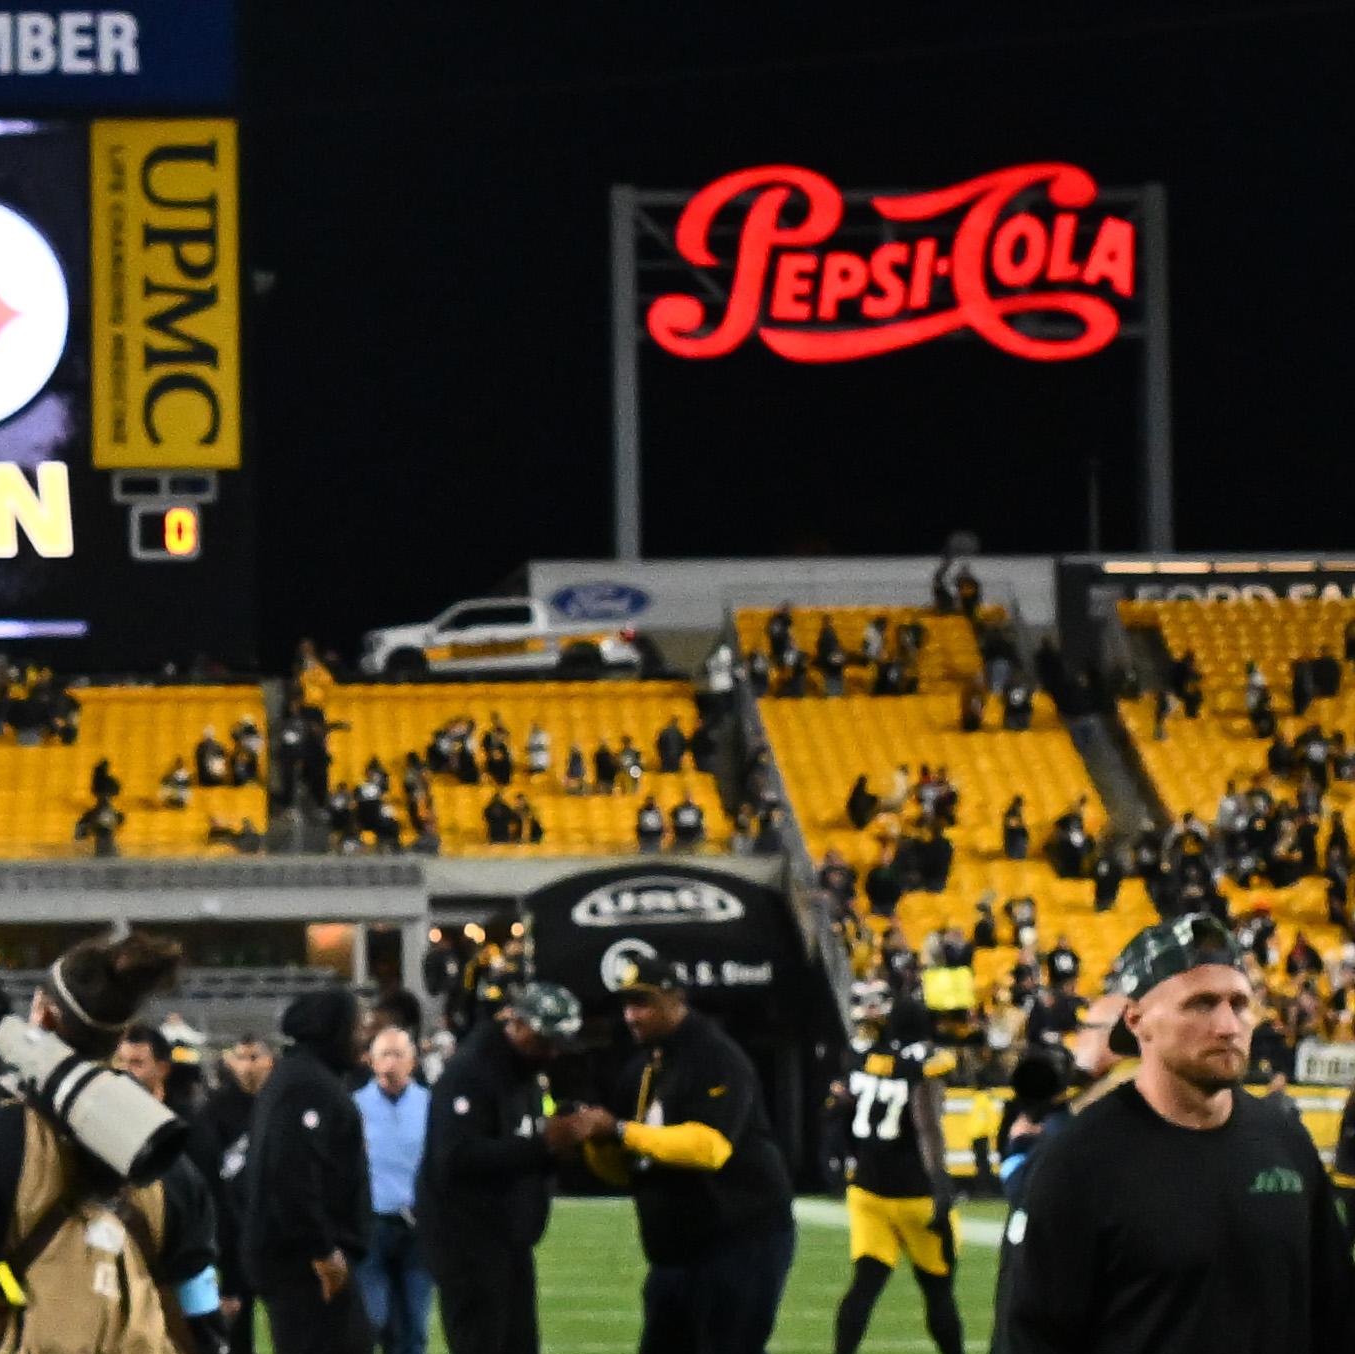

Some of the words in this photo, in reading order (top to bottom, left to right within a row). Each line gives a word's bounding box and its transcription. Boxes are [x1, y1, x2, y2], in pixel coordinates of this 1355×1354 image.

[141, 138, 222, 446] UPMC
[164, 506, 197, 556] 0
[848, 1070, 909, 1140] 77
